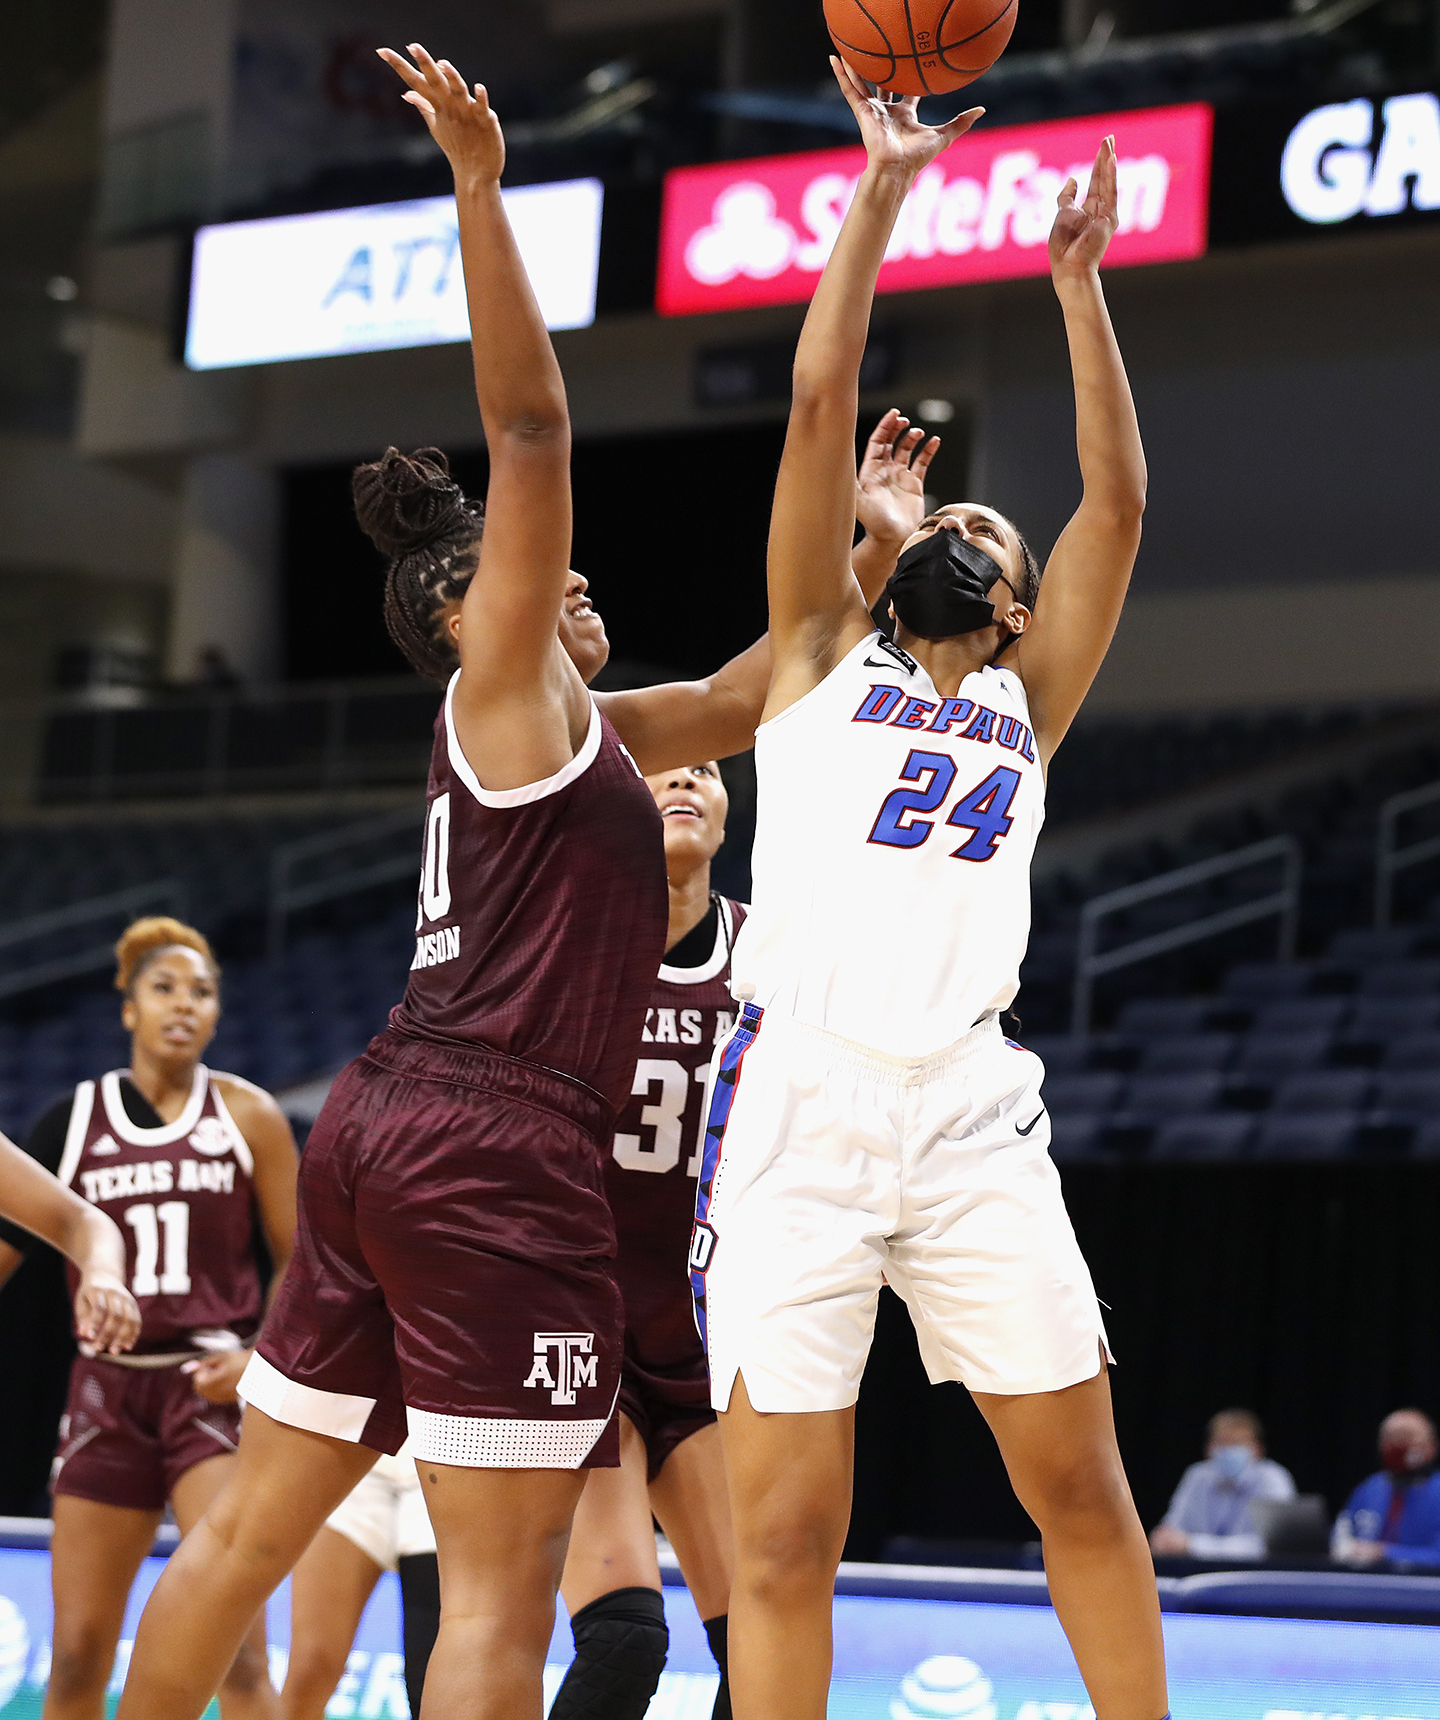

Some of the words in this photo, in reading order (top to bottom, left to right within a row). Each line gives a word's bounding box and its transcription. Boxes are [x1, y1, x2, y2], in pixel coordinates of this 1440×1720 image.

[866, 748, 1022, 863] 24
[415, 791, 452, 932] 0
[409, 925, 461, 971] NSON
[79, 1159, 174, 1204] TEXAS
[123, 1200, 192, 1297] 11
